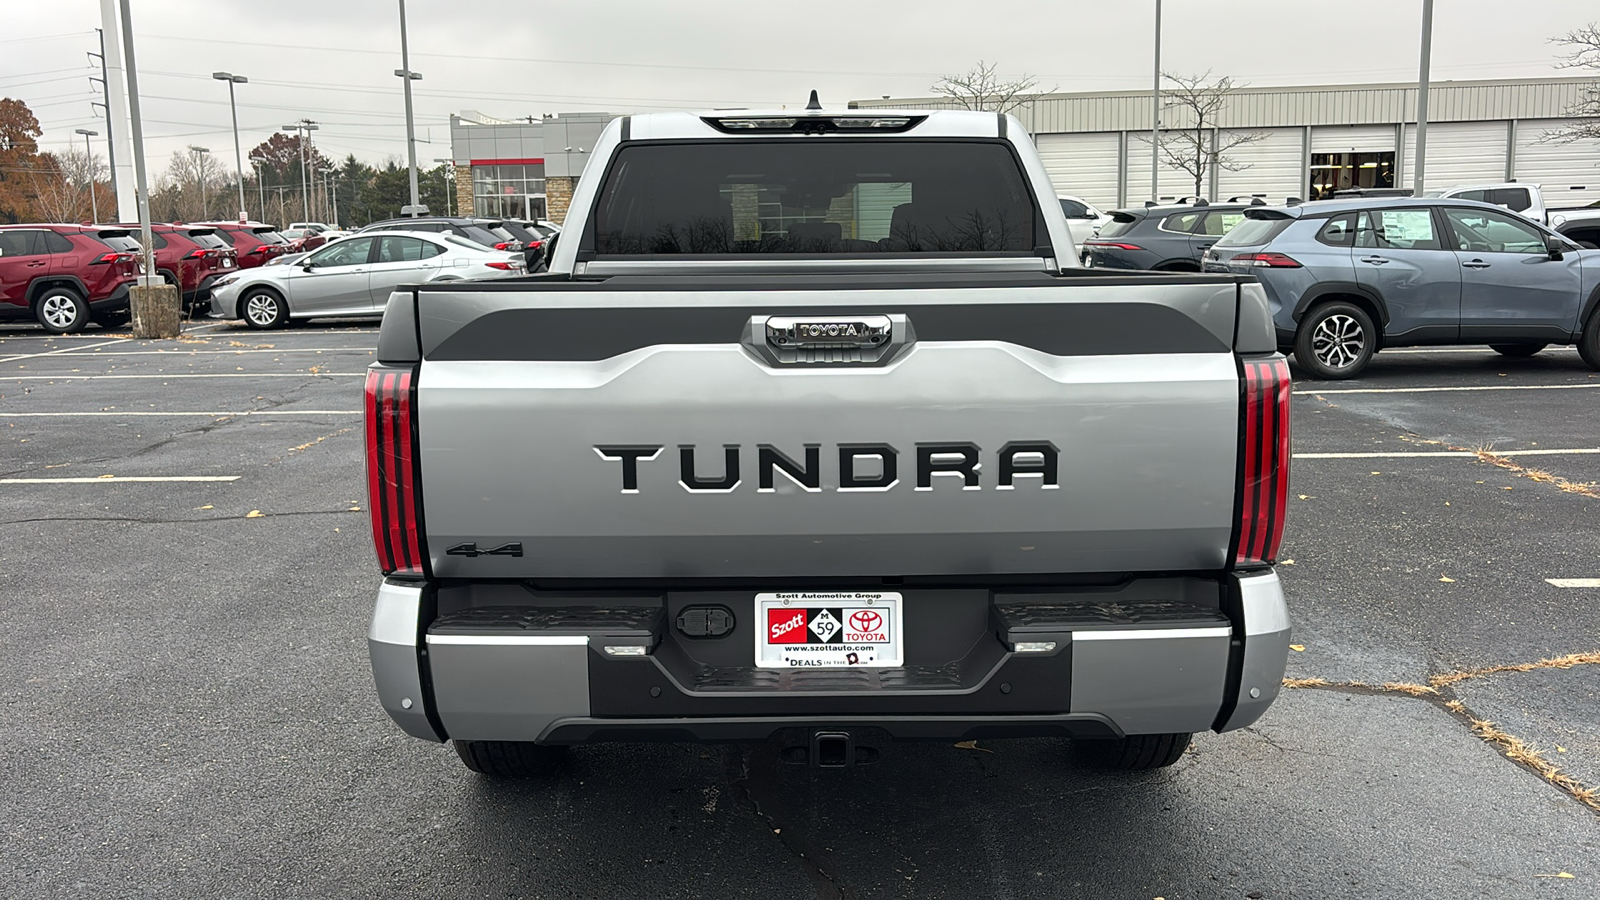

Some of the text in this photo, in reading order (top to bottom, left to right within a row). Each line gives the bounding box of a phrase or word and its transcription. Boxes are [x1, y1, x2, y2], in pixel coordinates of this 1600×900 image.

[800, 324, 857, 336] TOYOTA
[592, 440, 1060, 494] TUNDRA
[771, 613, 804, 638] Szott
[817, 622, 834, 636] 59
[845, 633, 886, 641] TOYOTA
[790, 659, 822, 667] DEALS
